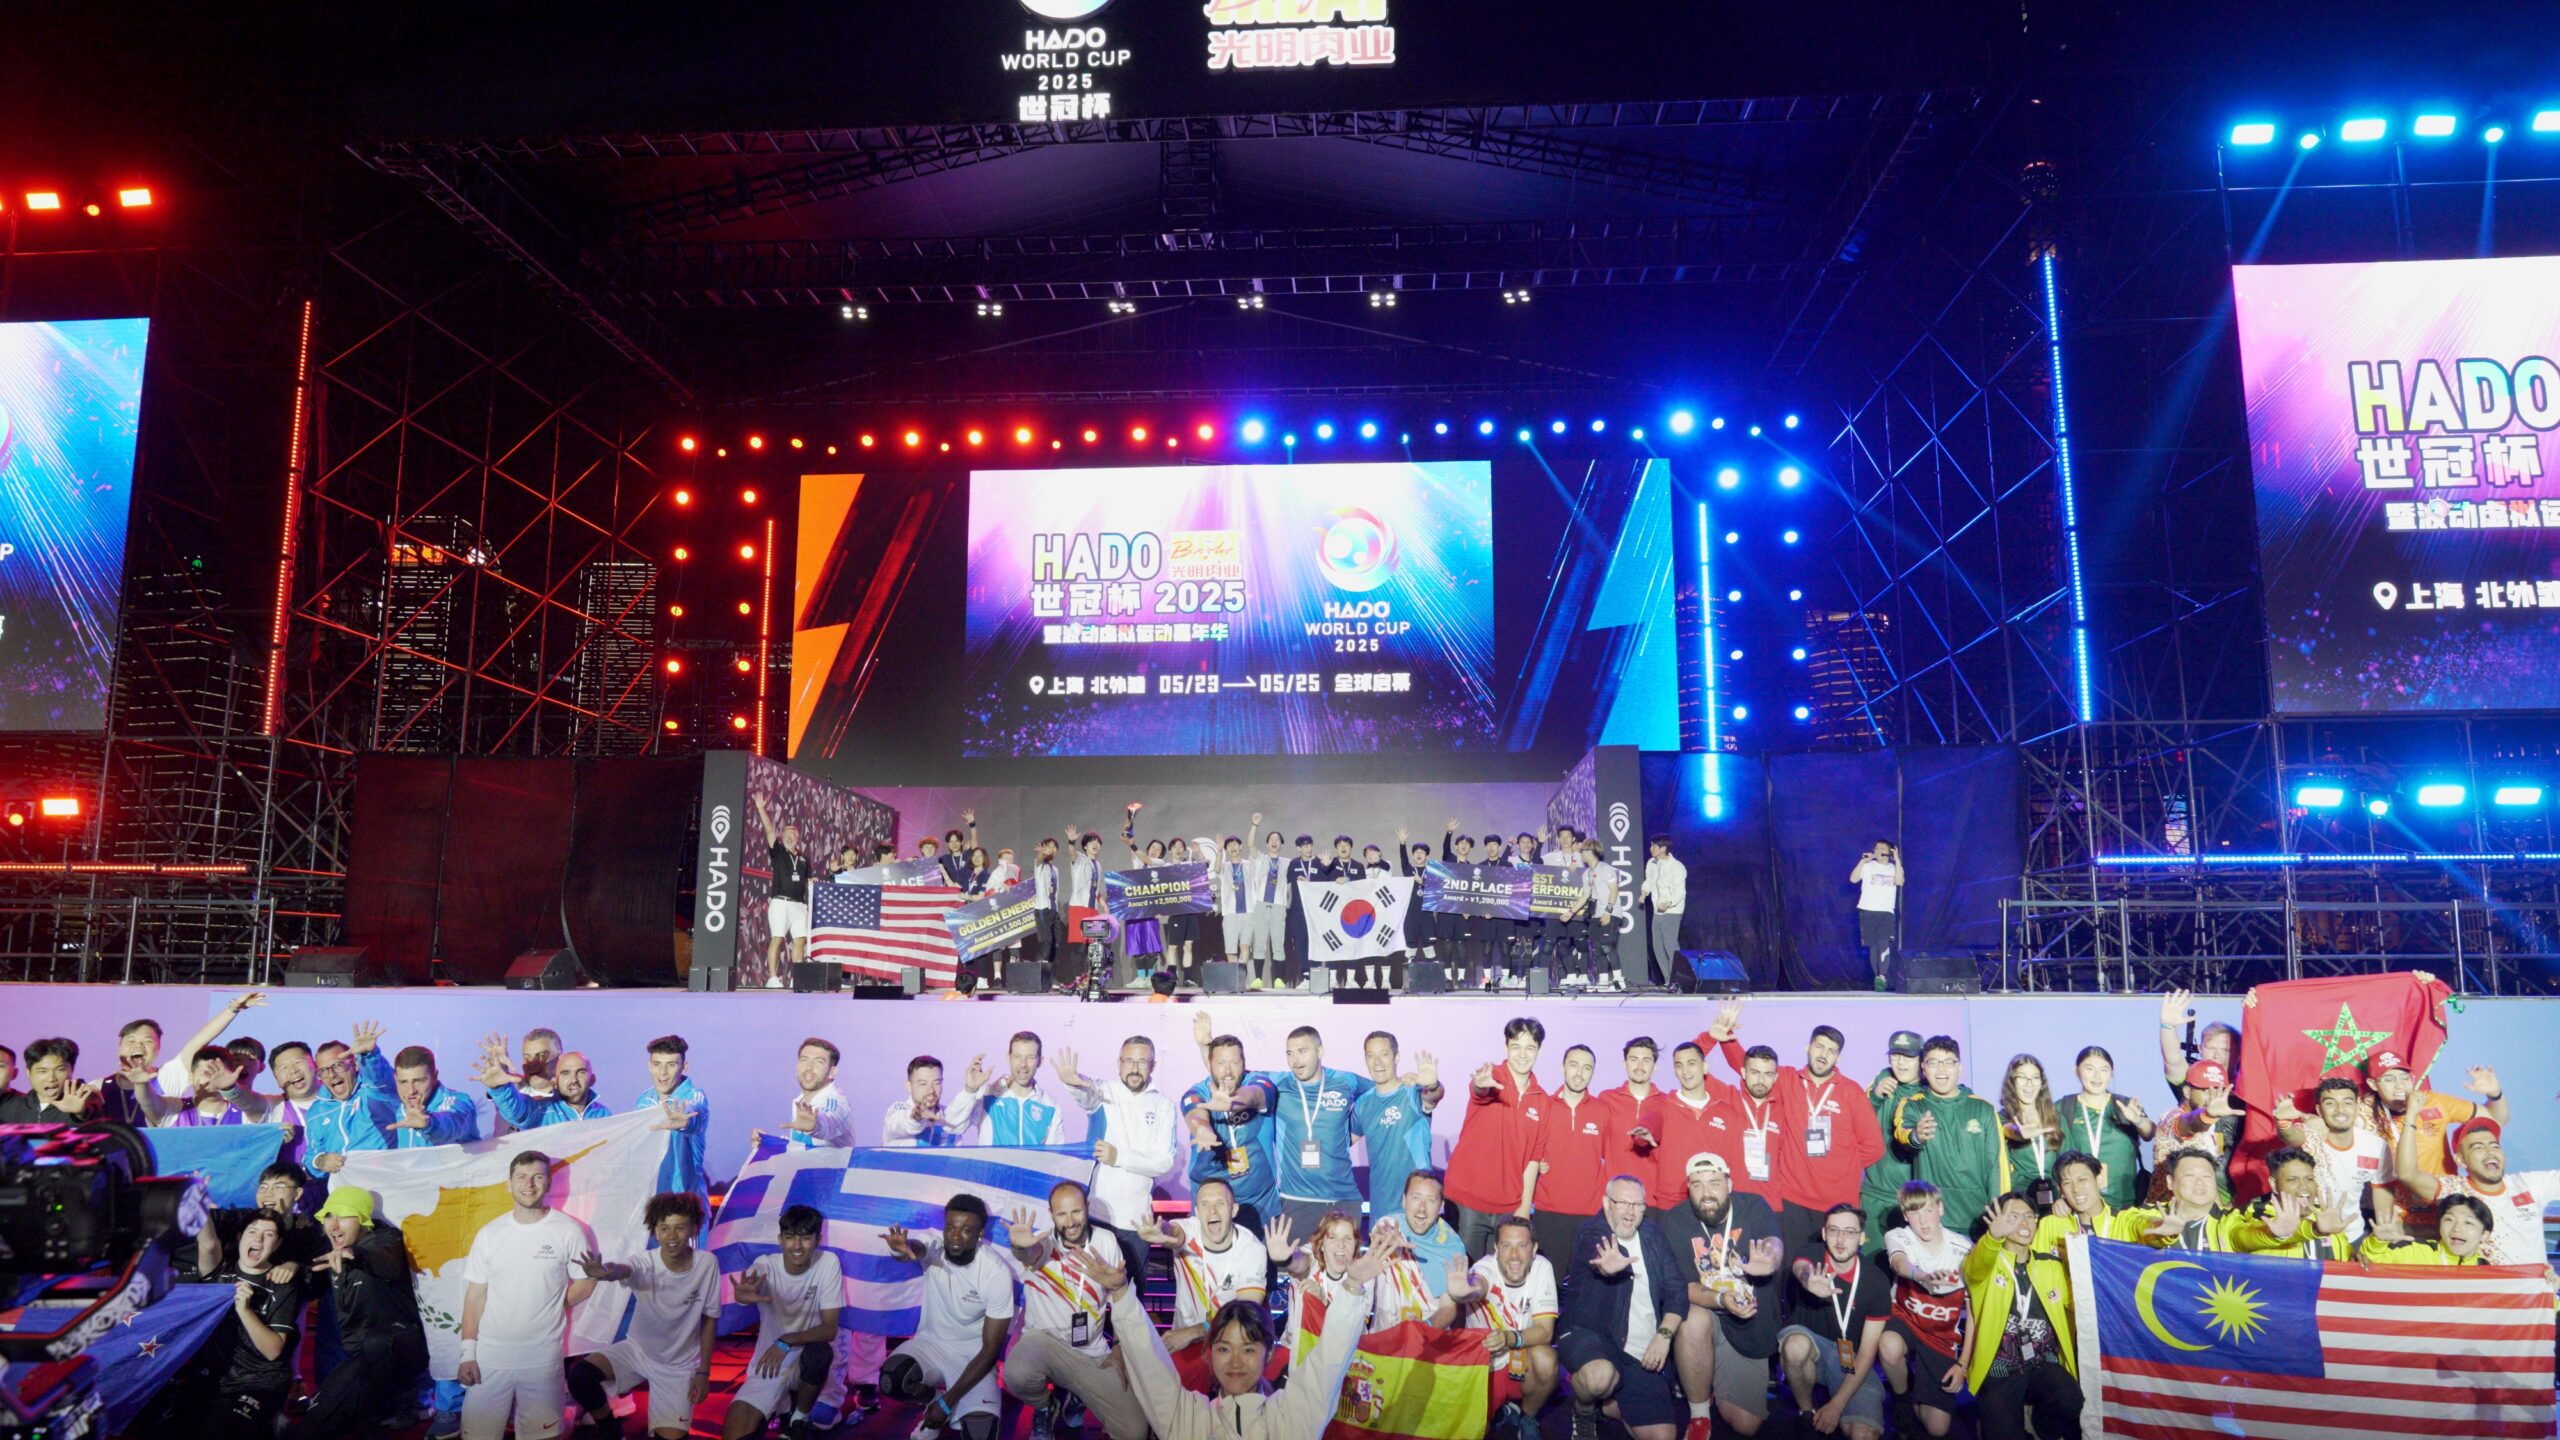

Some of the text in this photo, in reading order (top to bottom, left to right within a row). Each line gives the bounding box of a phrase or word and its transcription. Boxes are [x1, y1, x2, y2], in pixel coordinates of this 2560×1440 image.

[1025, 27, 1106, 51] HADO
[1209, 28, 1395, 66] 光明肉业
[1001, 50, 1131, 69] WORLD CUP
[1038, 73, 1093, 91] 2025
[1018, 93, 1110, 122] 世冠杯
[2347, 356, 2560, 435] HADO
[2355, 435, 2544, 490] 世冠杯
[1032, 531, 1162, 581] HADO
[1171, 563, 1240, 579] 光明肉业
[1030, 580, 1246, 617] 世冠杯 2025
[2405, 582, 2465, 610] 上海
[1324, 601, 1391, 619] HADO
[1305, 621, 1411, 636] WORLD CUP
[1335, 638, 1379, 653] 2025
[1048, 676, 1084, 695] 上海
[1159, 674, 1219, 694] 05/23
[1260, 673, 1320, 693] 05/25
[1124, 880, 1190, 897] CHAMPION
[1442, 878, 1513, 895] 2ND PLACE
[1532, 873, 1554, 884] EST
[704, 847, 729, 932] HADO
[1442, 893, 1464, 903] Award
[1127, 898, 1148, 908] Award
[1532, 898, 1553, 906] Award
[959, 912, 1001, 936] GOLDEN
[1904, 1295, 1959, 1322] acer
